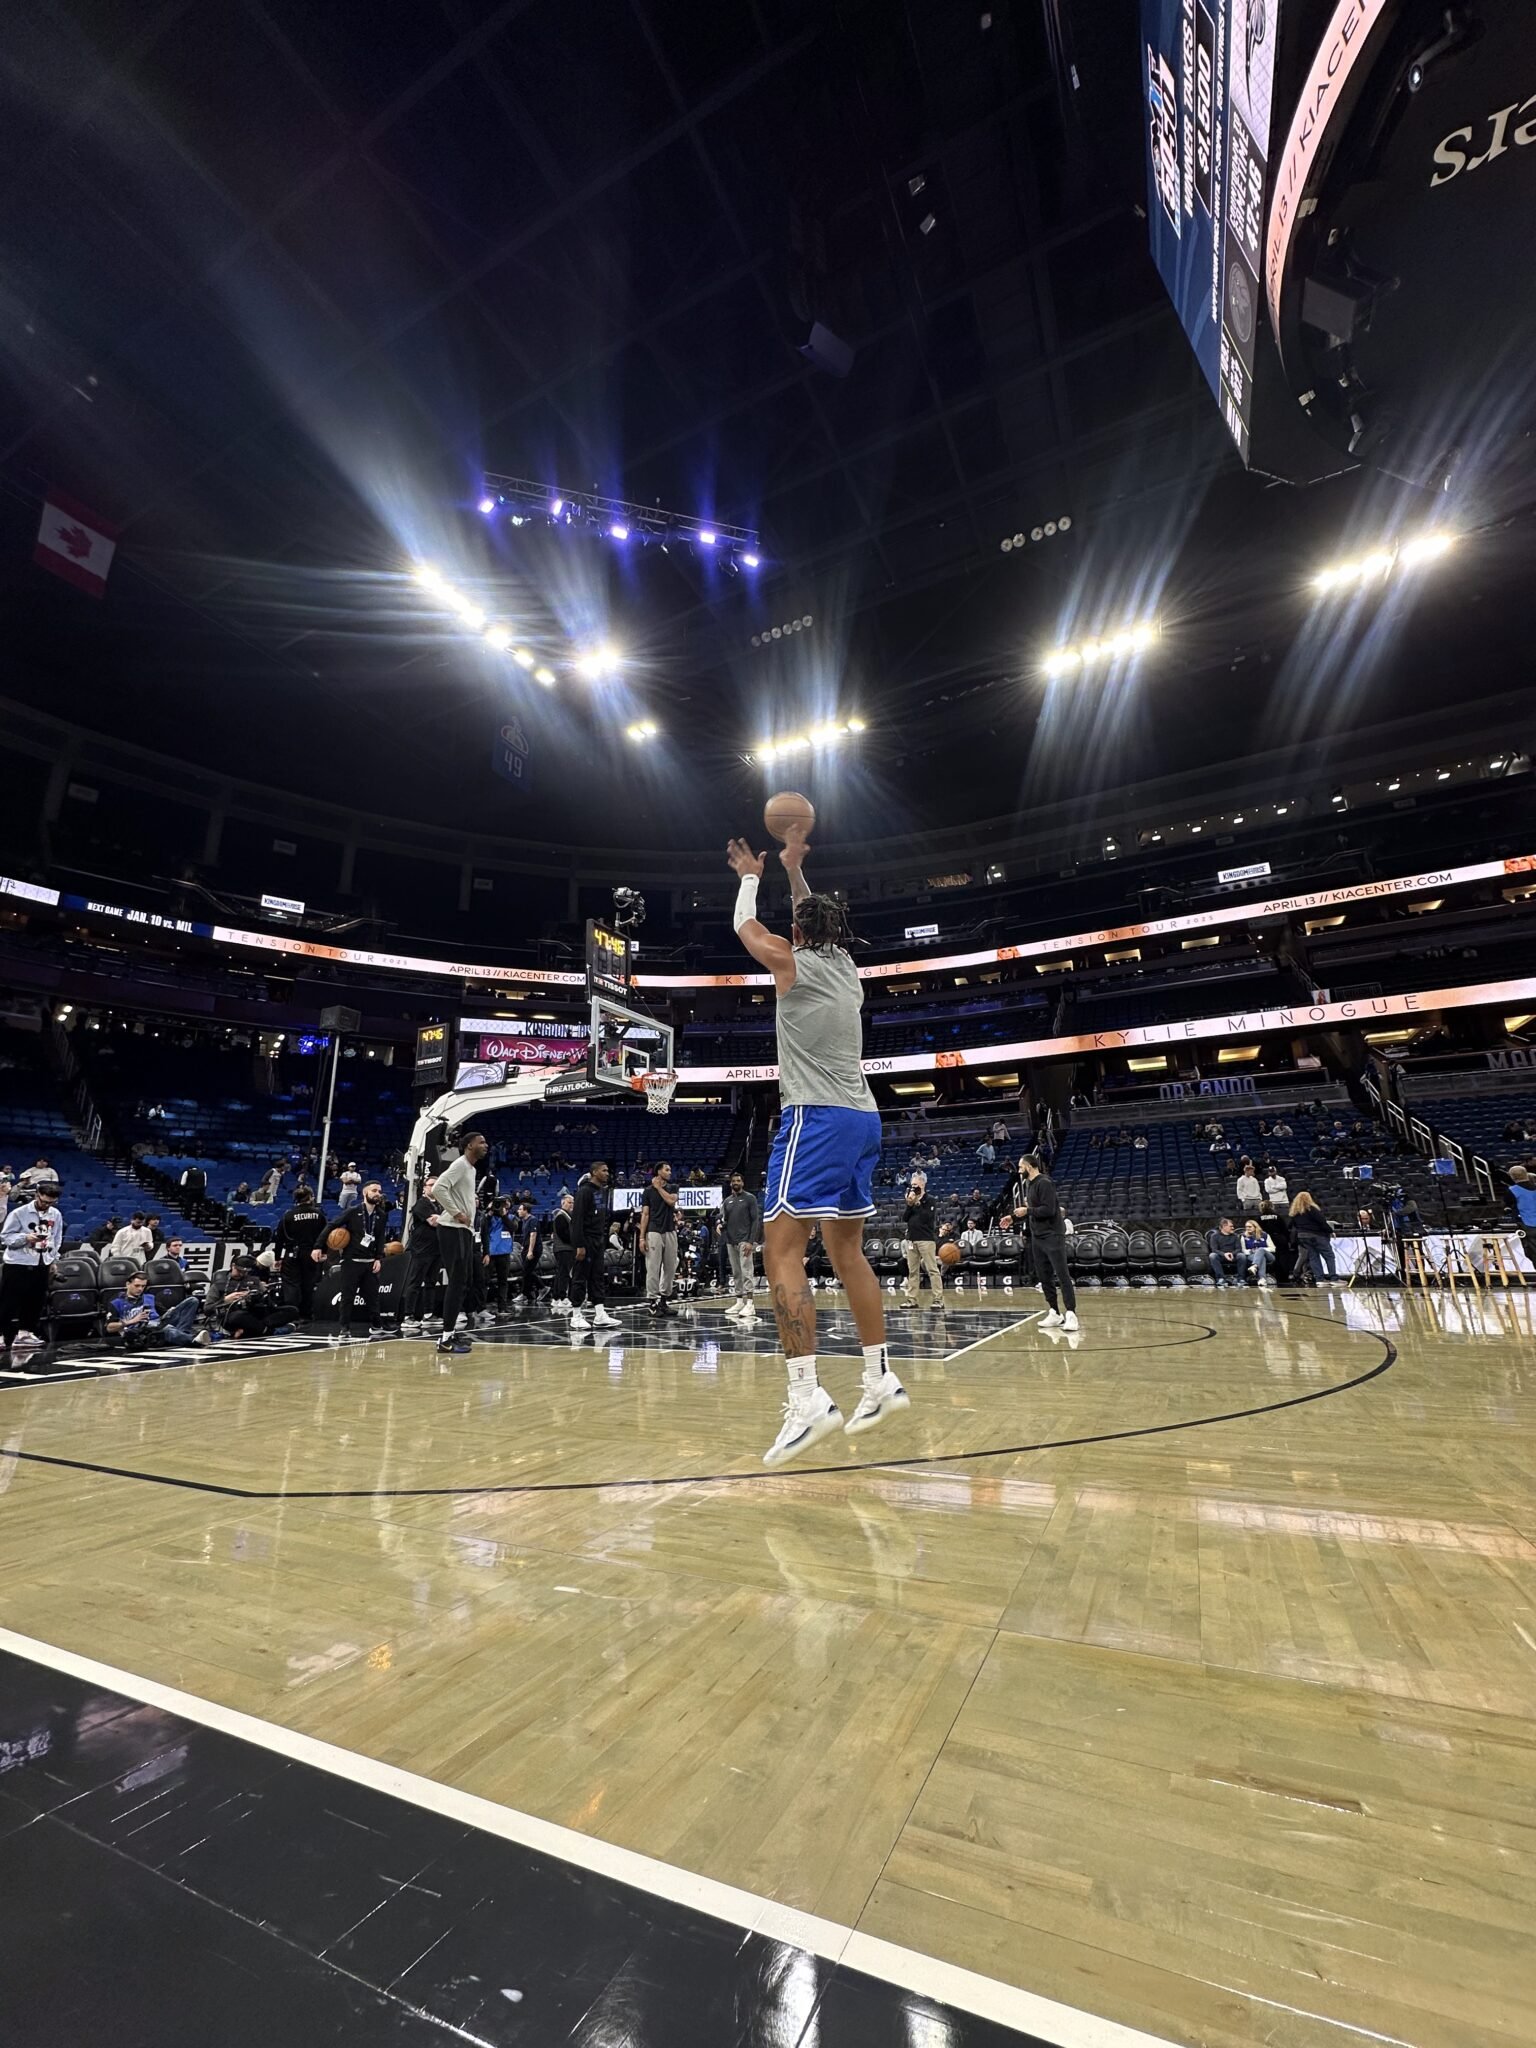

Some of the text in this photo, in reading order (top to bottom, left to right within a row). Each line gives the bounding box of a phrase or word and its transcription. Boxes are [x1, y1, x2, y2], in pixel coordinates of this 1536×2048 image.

[1183, 18, 1193, 112] TAKES
[1198, 43, 1211, 174] $1,500
[1183, 114, 1193, 218] WINNER
[1235, 129, 1249, 242] GAMETIME
[1246, 158, 1262, 251] 47:46
[1278, 194, 1289, 226] 13
[1263, 898, 1302, 913] APRIL
[1304, 896, 1316, 906] 13
[1332, 872, 1453, 900] KIACENTER.COM
[87, 902, 193, 934] NEXT GAME JAN. 10 vs. MIL
[228, 930, 316, 954] TENSION
[328, 948, 375, 963] TOUR
[1042, 930, 1119, 951] TENSION
[1129, 920, 1178, 935] TOUR
[449, 965, 481, 976] APRIL
[482, 968, 491, 976] 13
[503, 969, 585, 984] KIACENTER.COM
[604, 980, 628, 996] TISSOT
[725, 976, 772, 985] KYLI
[1093, 995, 1421, 1048] KYLIE MINOGUE
[545, 1081, 596, 1095] THREATLOCKE
[725, 1069, 761, 1079] APRIL
[765, 1068, 775, 1078] 13
[1159, 1076, 1256, 1101] ORLANDO
[686, 1190, 710, 1206] RISE
[293, 1212, 319, 1222] SECURITY
